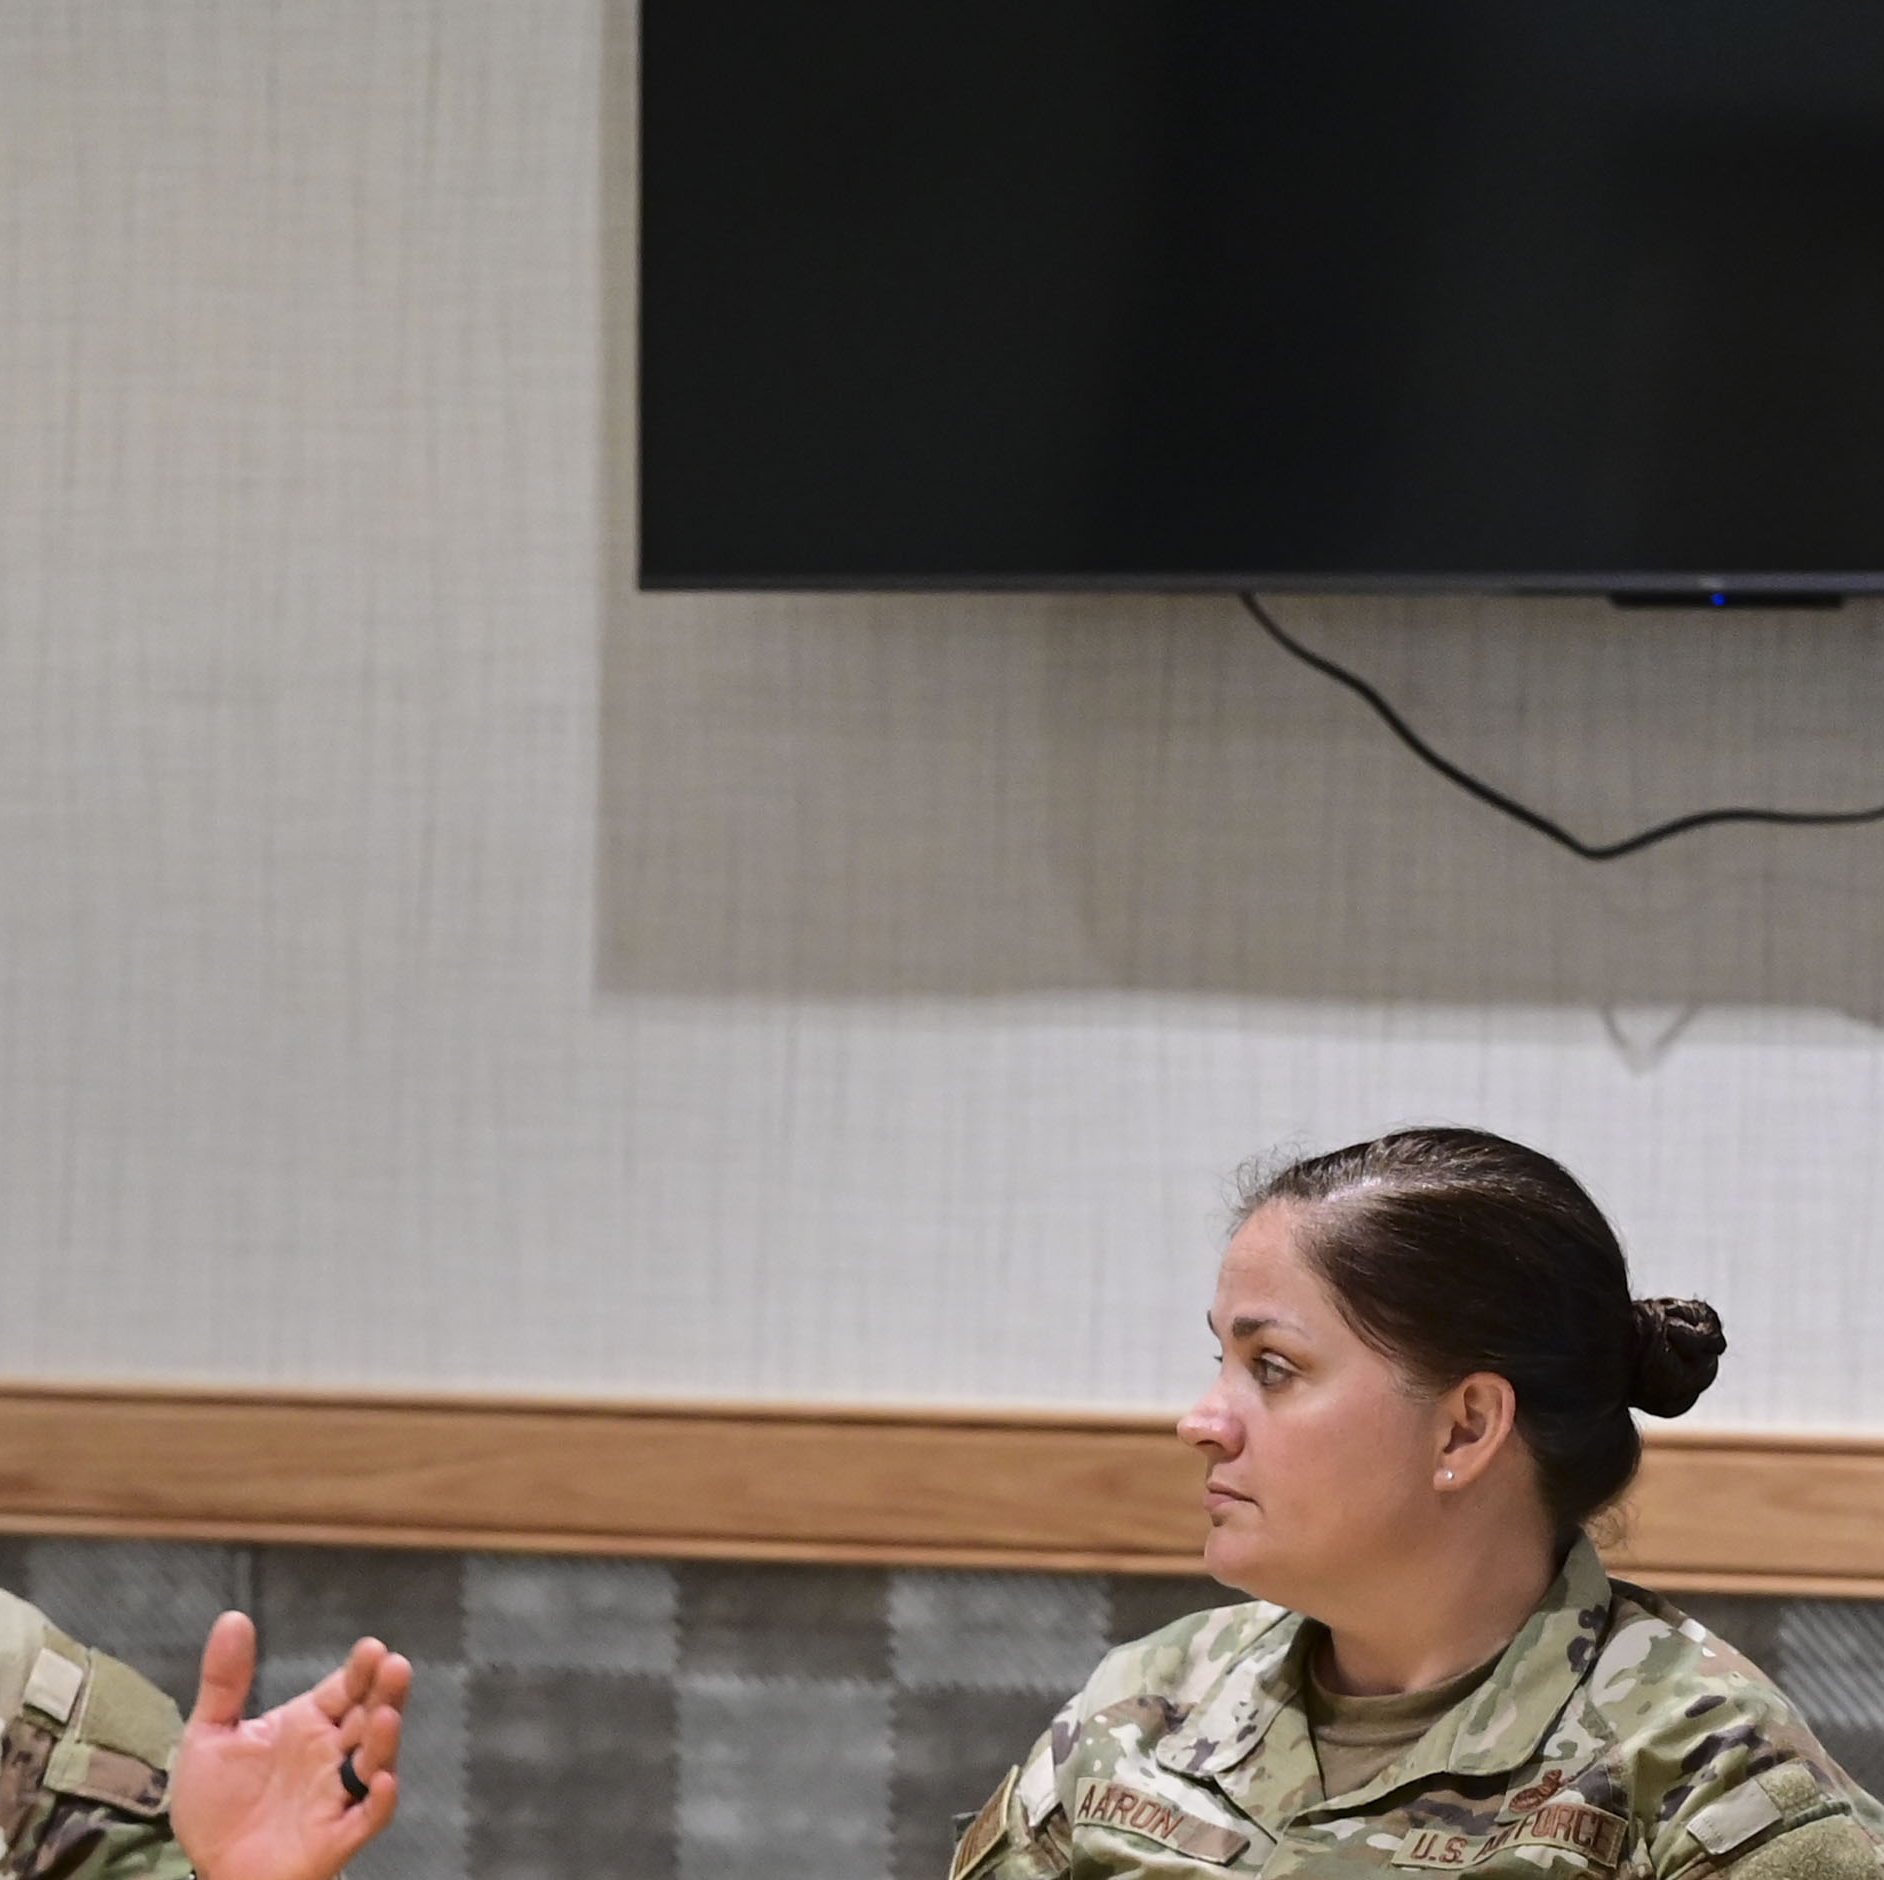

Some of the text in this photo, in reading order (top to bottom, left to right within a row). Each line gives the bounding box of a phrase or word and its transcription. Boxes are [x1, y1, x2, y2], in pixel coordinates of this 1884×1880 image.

[1077, 1783, 1185, 1840] AARON
[1410, 1831, 1468, 1864] U.S.
[1513, 1804, 1613, 1856] FORCE
